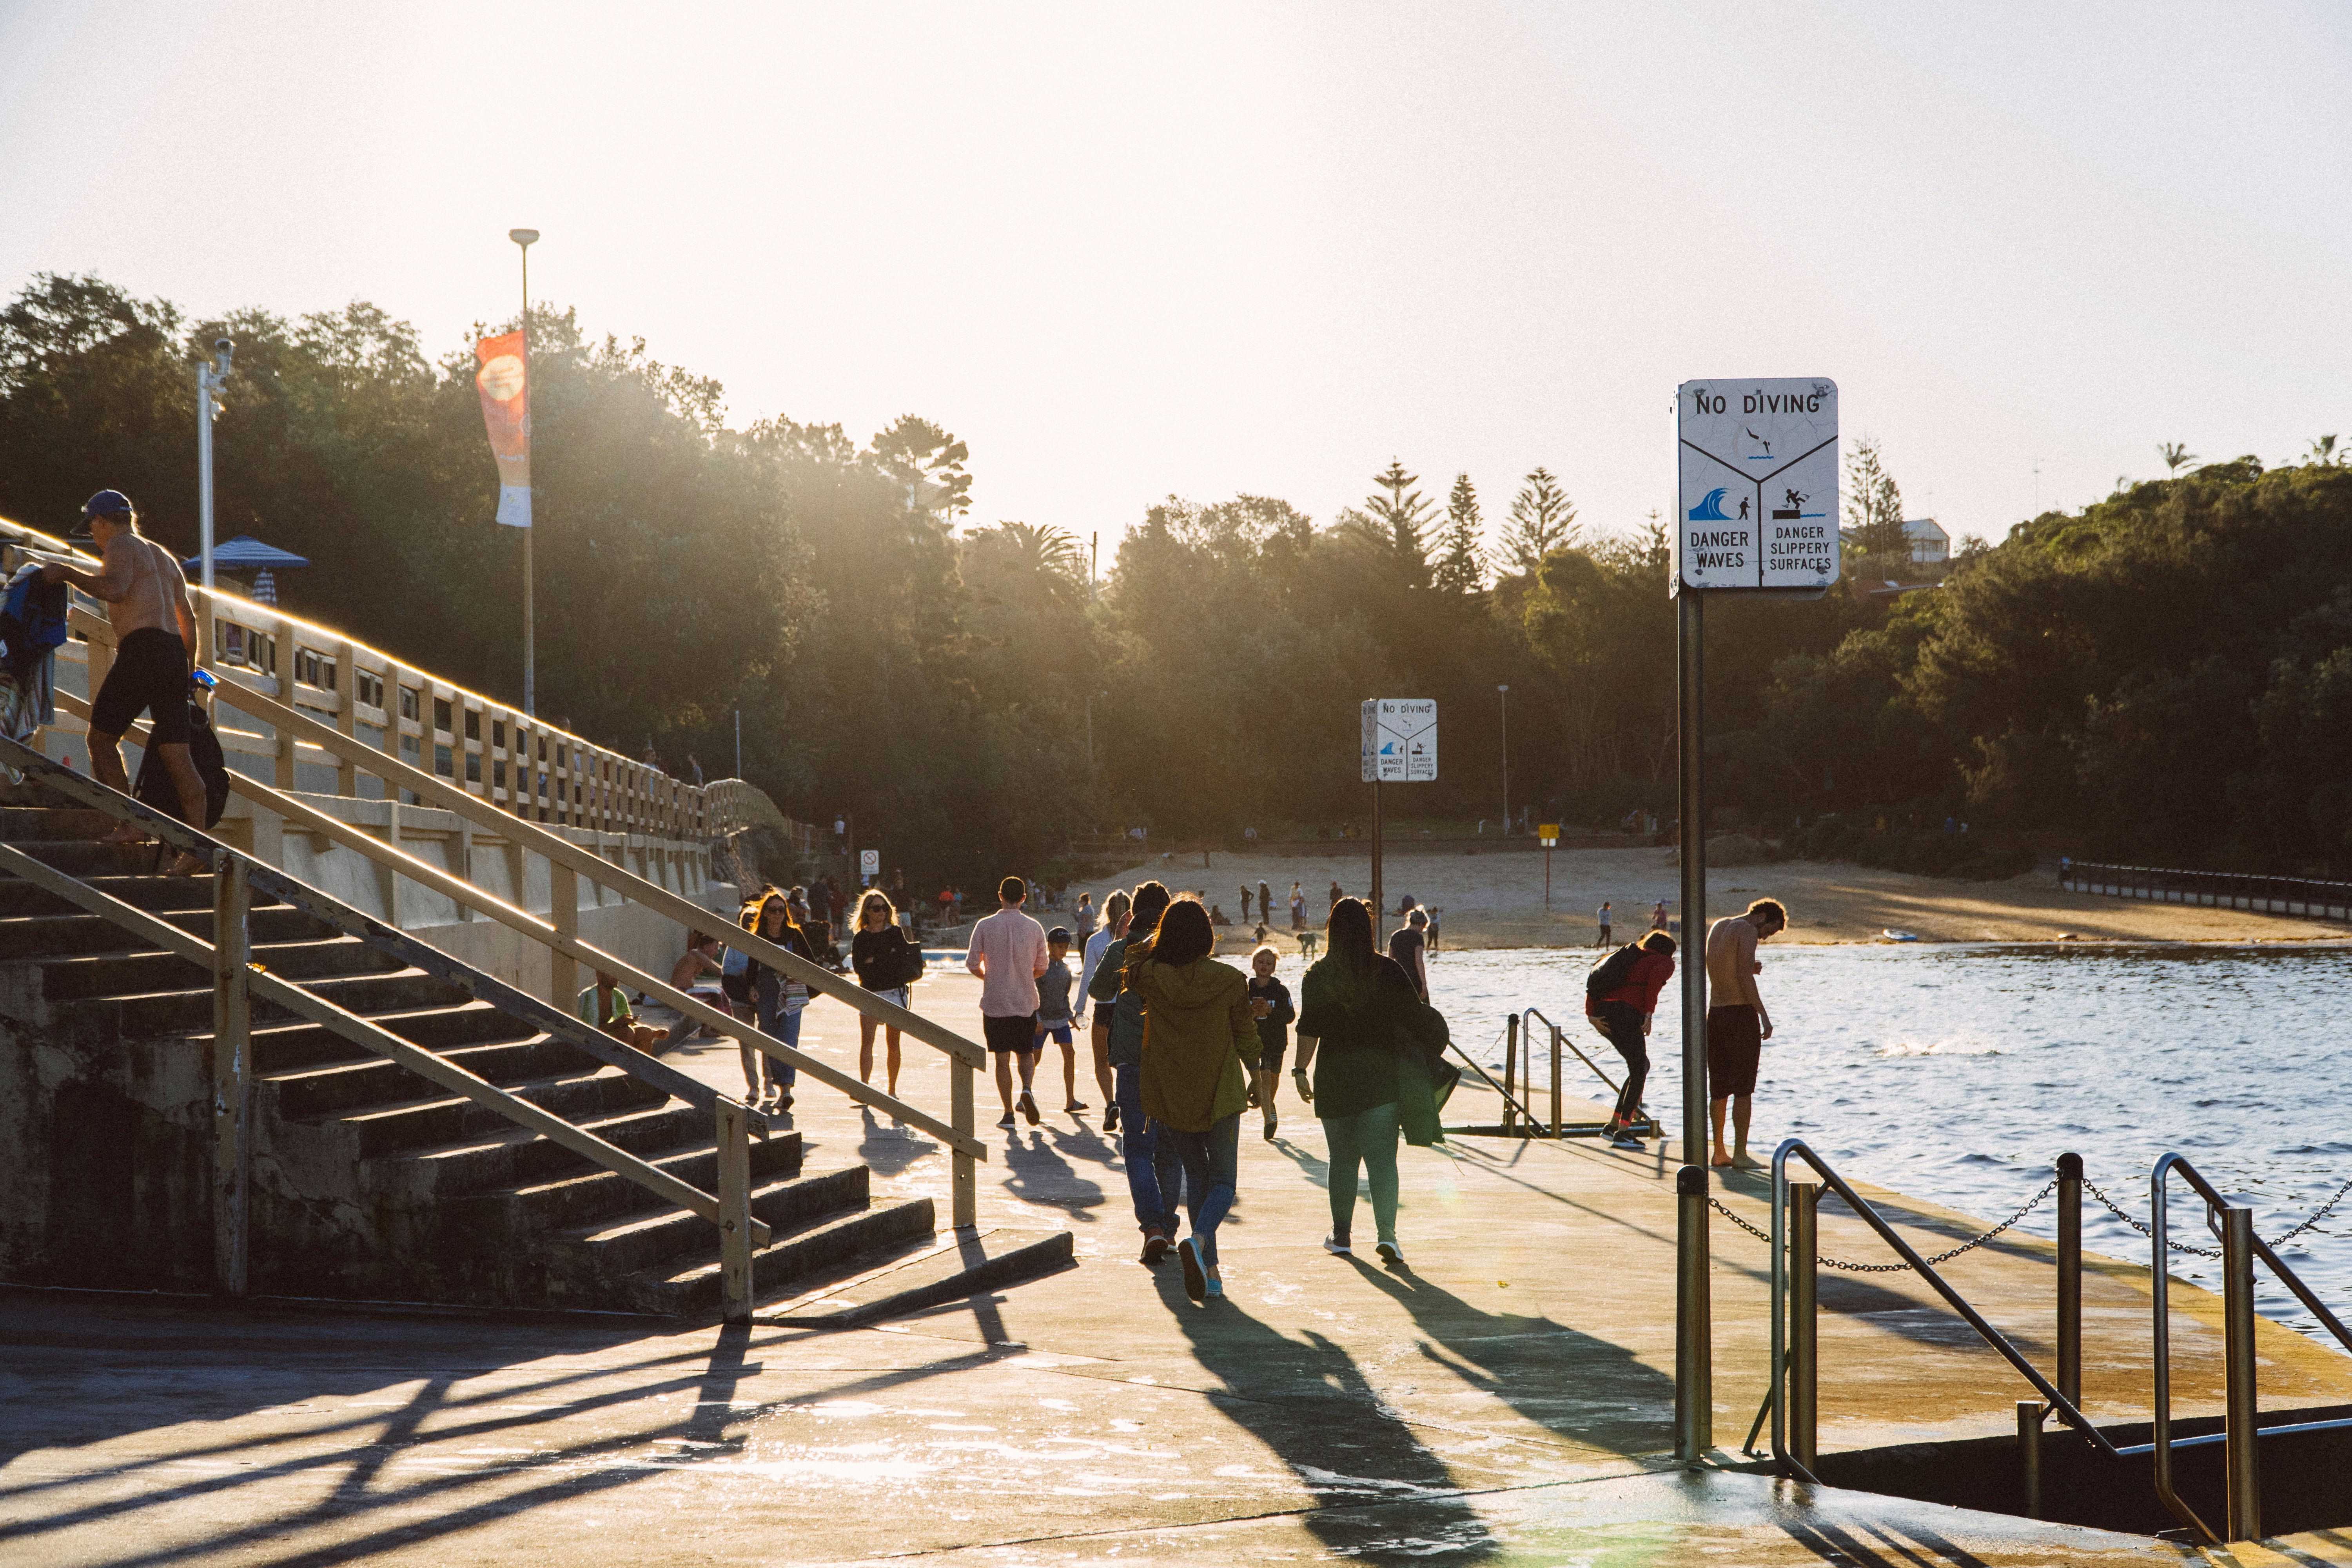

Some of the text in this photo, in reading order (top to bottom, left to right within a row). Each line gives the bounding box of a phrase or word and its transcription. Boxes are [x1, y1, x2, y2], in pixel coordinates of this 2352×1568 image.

[1697, 394, 1820, 414] NO DIVING
[1691, 532, 1748, 547] DANGER
[1775, 527, 1824, 539] DANGER
[1771, 543, 1830, 554] SLIPPERY
[1697, 553, 1744, 568] WAVES
[1770, 558, 1831, 570] SURFACES
